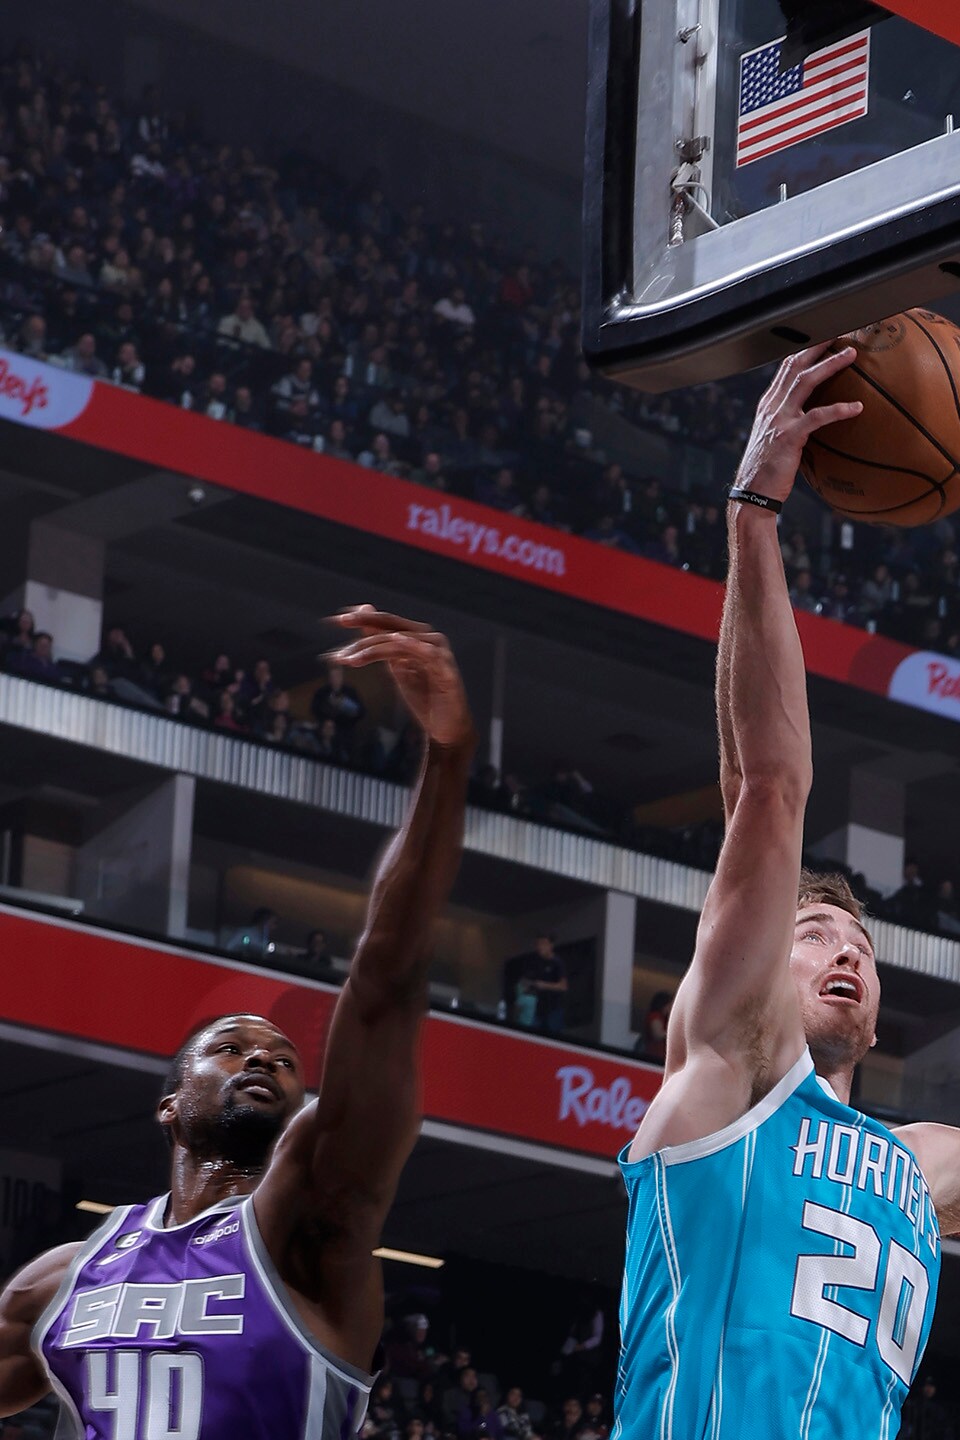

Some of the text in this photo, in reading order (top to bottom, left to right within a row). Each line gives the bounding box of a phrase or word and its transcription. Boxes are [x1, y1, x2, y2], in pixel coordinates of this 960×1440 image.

[407, 503, 567, 576] raleys.com
[556, 1065, 648, 1132] Rale
[789, 1116, 938, 1260] HORNETS
[60, 1272, 246, 1350] SAC
[790, 1198, 931, 1388] 20
